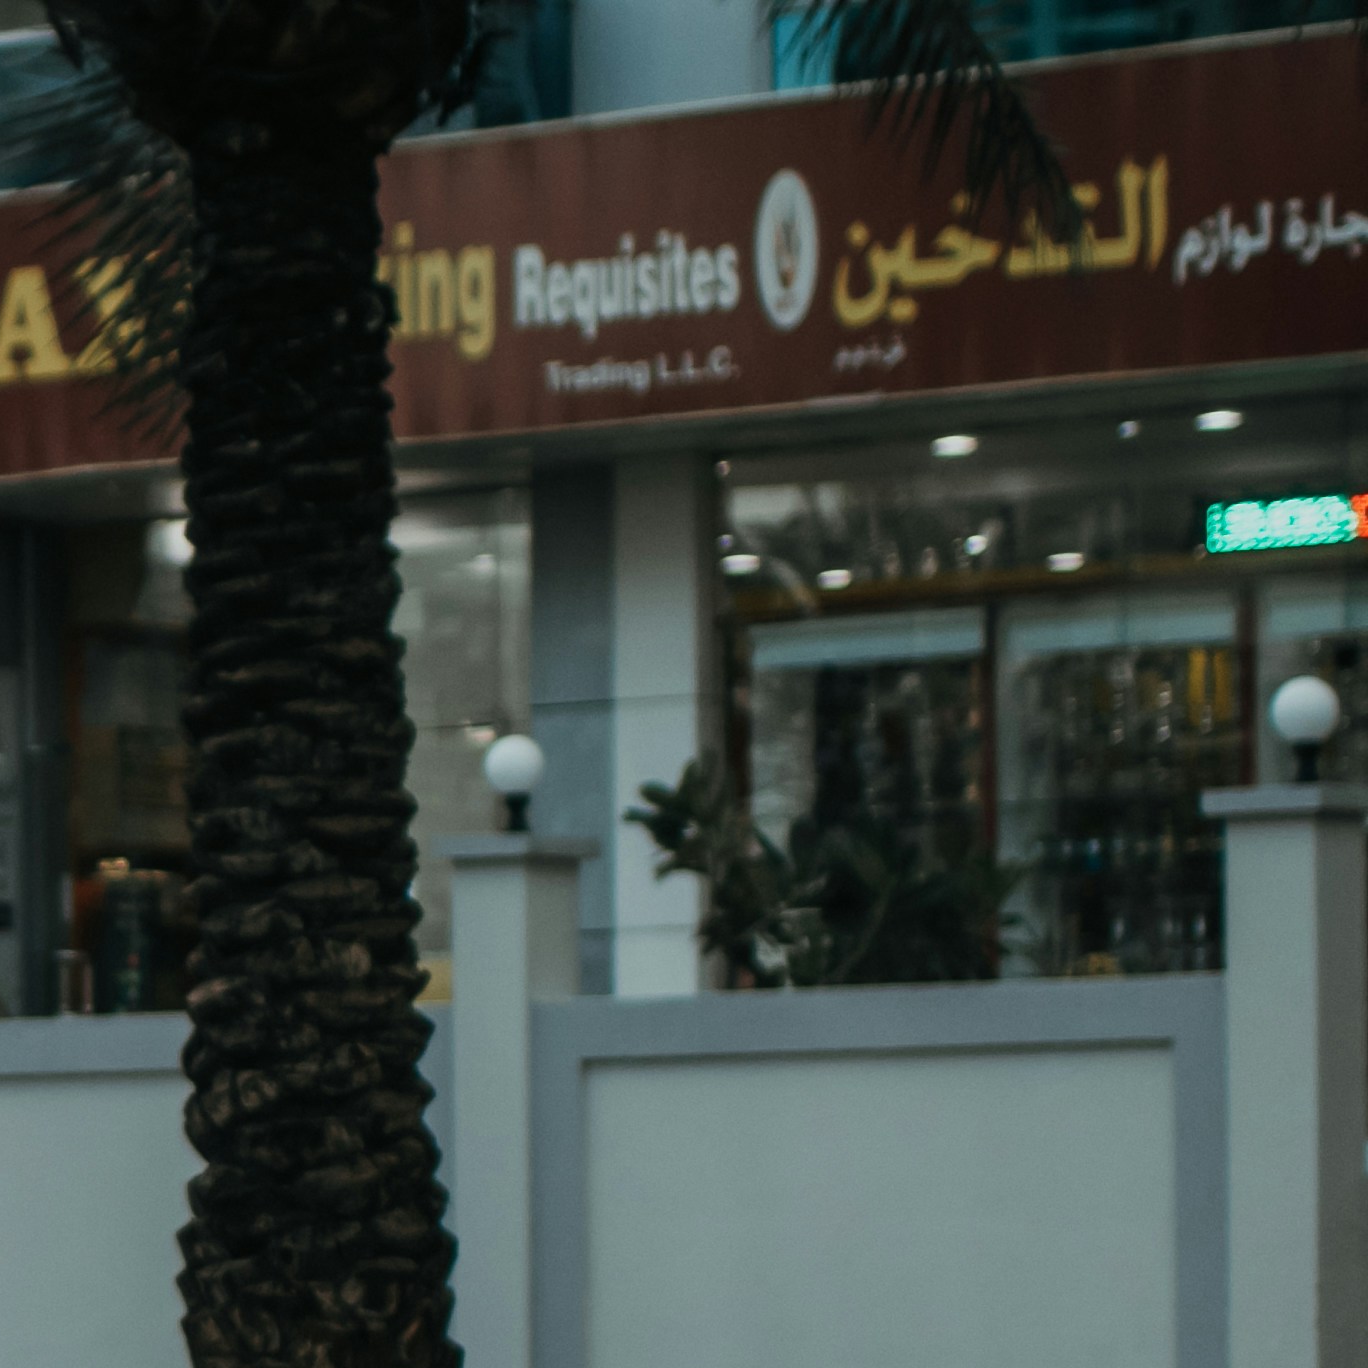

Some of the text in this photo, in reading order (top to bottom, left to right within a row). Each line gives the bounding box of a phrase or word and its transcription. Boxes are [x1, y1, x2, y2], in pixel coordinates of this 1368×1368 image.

[1283, 193, 1368, 265] جارة
[512, 227, 741, 341] Requisites
[545, 356, 651, 394] Trading
